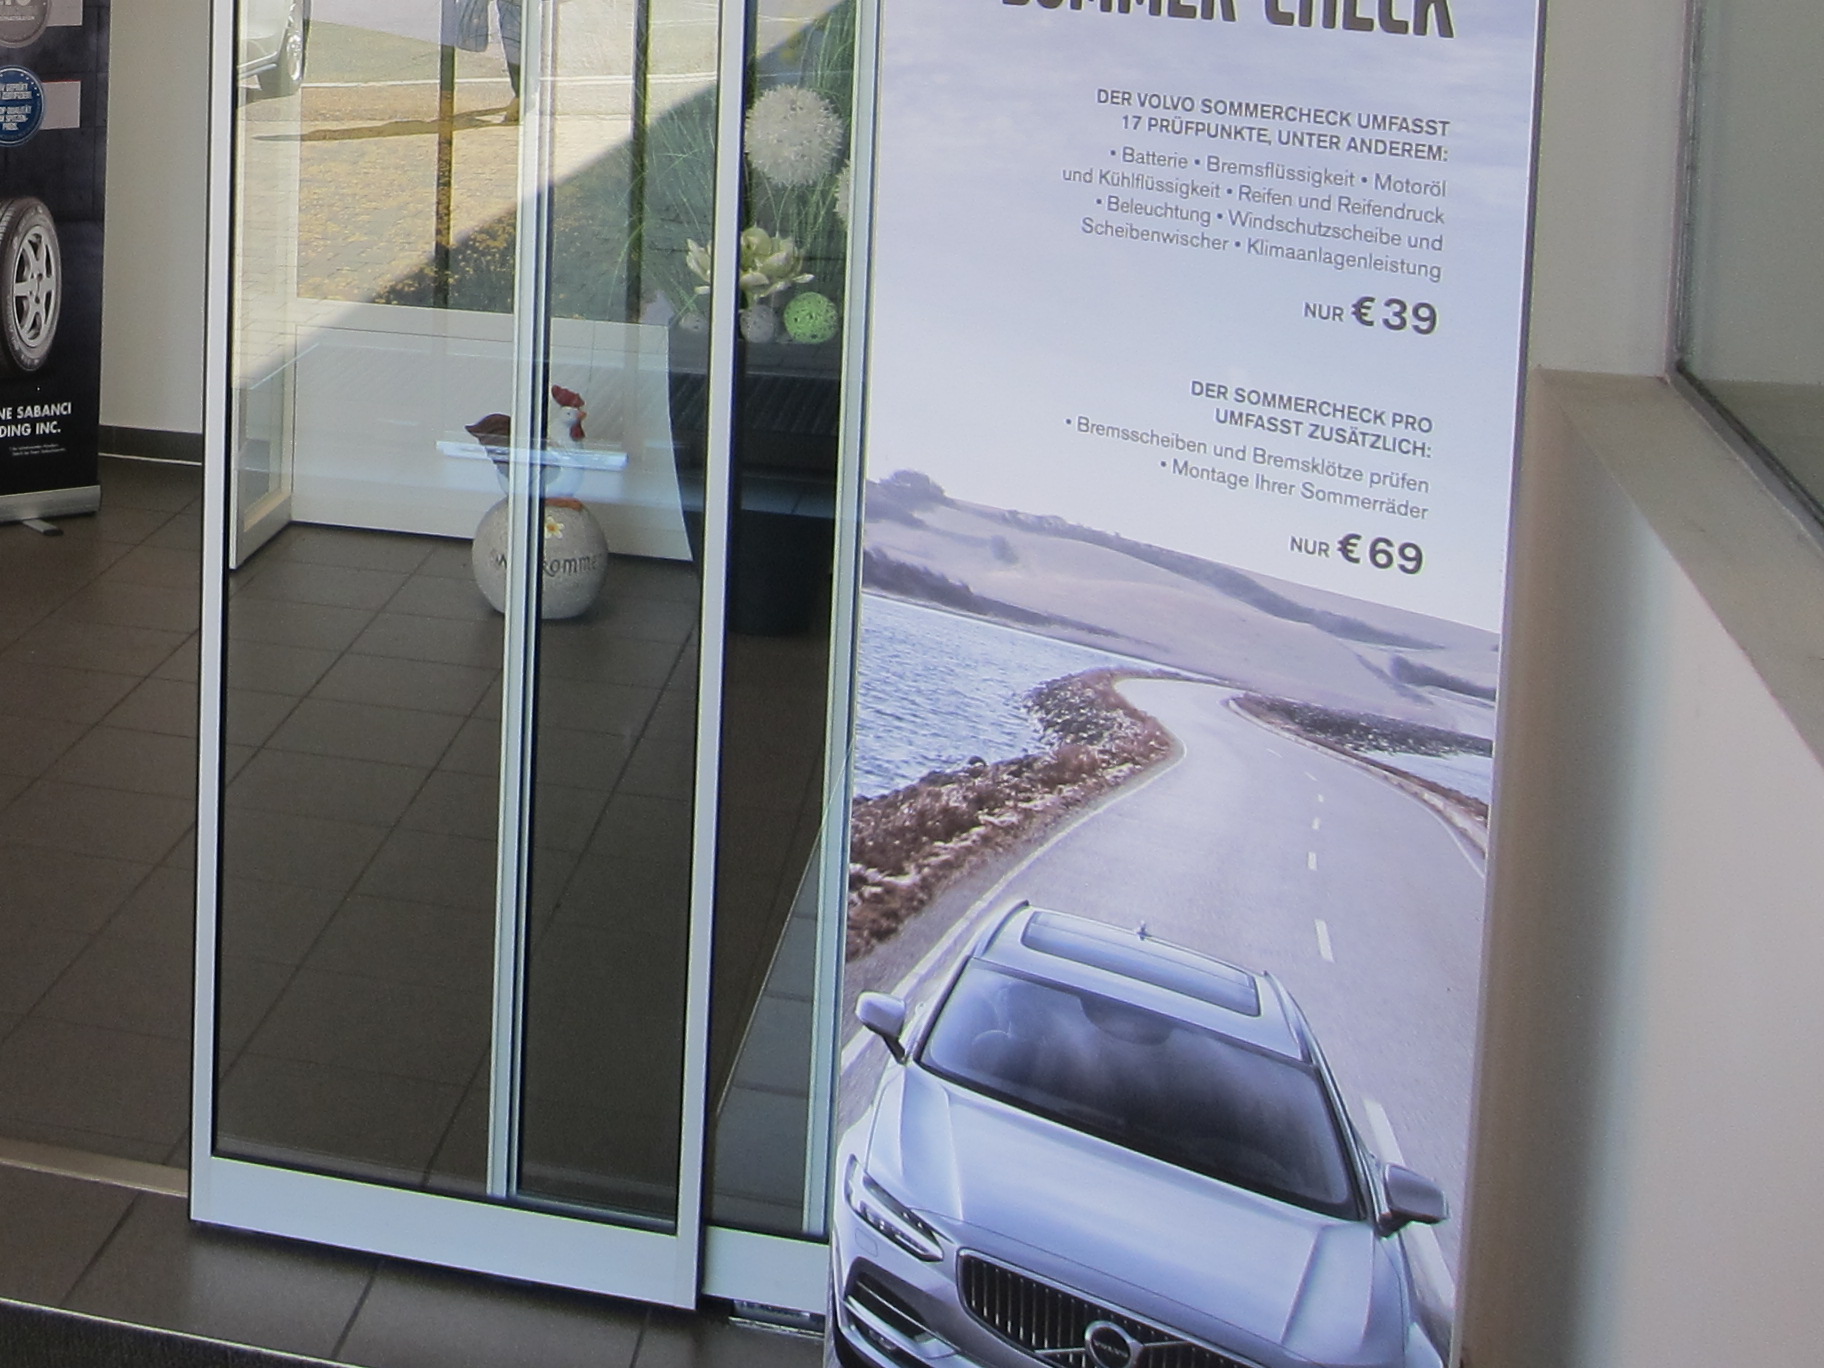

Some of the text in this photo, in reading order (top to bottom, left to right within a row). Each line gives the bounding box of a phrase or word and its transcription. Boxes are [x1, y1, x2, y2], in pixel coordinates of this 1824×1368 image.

[1098, 89, 1450, 136] DER VOLVO SOMMERCHECK UMFASST
[1123, 115, 1448, 161] 17 PRÜFPUNKTE, UNTER ANDEREM:
[1123, 146, 1446, 197] Batterie Bremsflüssigkeit Motoröl
[1063, 170, 1444, 224] und Kühlflüssigkeit Reifen und Reifendruck
[1108, 195, 1443, 251] Beleuchtung Windschutzscheibe und
[1082, 217, 1441, 283] Scheibenwischer Klimaanlagenleistung
[1304, 301, 1344, 321] NUR
[17, 402, 71, 418] SABANCI
[36, 421, 61, 434] INC.
[1192, 381, 1432, 433] DER SOMMERCHECK PRO
[1078, 416, 1429, 493] Bremsscheiben und Bremsklötze prüfen
[1216, 408, 1431, 458] UMFASST ZUSÄTZLICH:
[1173, 458, 1428, 519] Montage Ihrer Sommerräder
[1290, 536, 1330, 558] NUR
